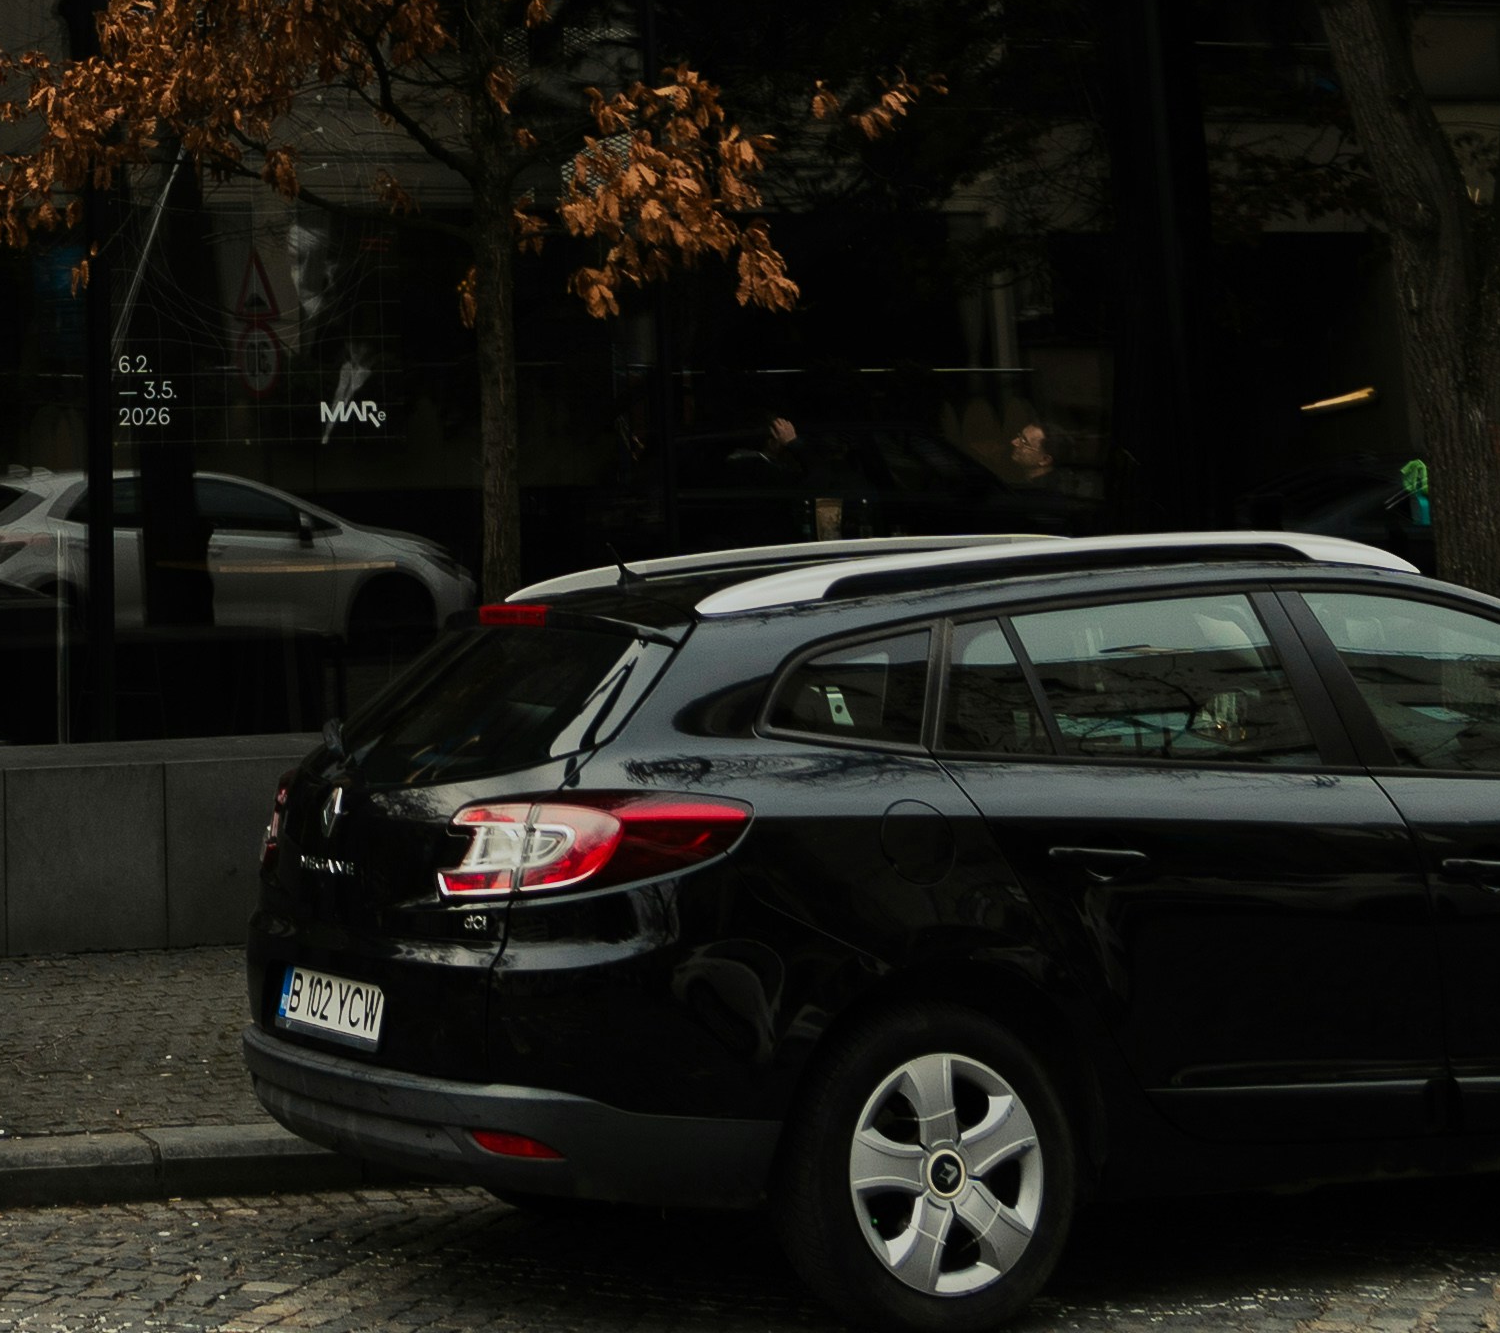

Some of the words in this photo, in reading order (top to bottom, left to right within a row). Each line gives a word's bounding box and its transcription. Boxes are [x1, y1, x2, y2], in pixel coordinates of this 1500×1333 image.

[117, 354, 153, 374] 6.2.
[143, 380, 178, 400] 3.5.
[117, 406, 171, 427] 2026
[288, 972, 304, 1013] B
[306, 976, 333, 1022] 102
[338, 981, 382, 1033] YCW
